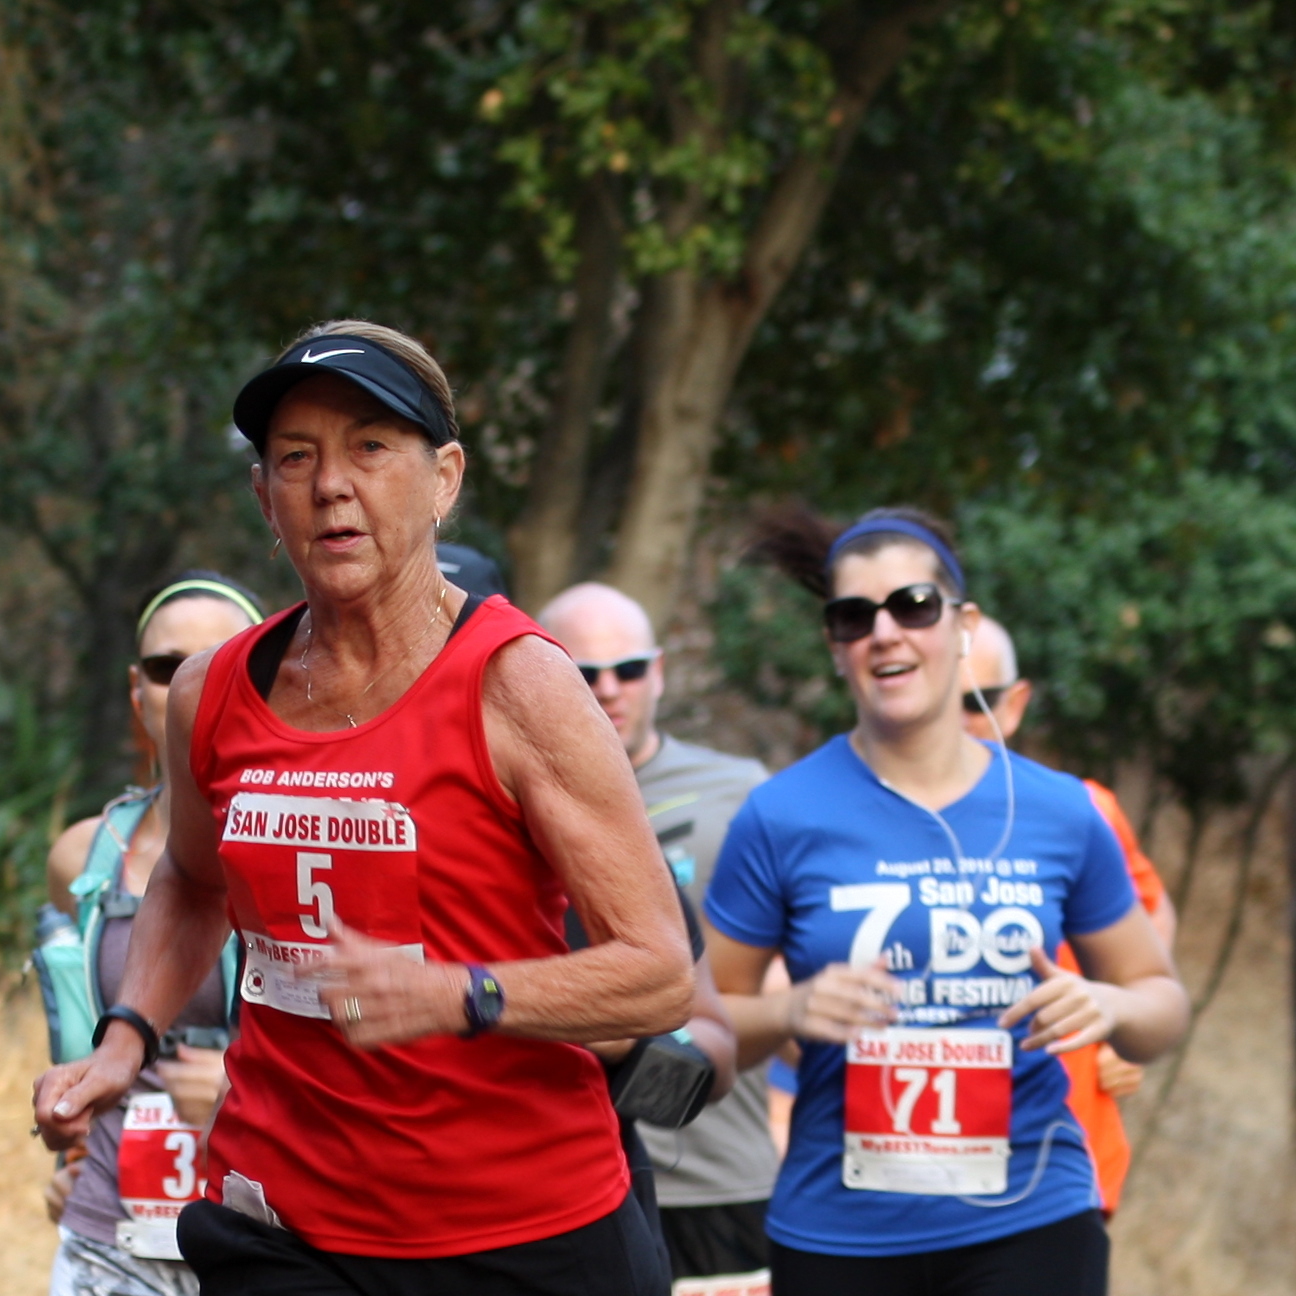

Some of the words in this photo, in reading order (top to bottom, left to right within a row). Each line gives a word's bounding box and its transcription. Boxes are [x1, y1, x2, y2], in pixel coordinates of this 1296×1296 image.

[240, 768, 275, 786] BOB
[277, 770, 395, 788] ANDERSON'S
[230, 810, 269, 837] SAN
[272, 812, 321, 842] JOSE
[327, 816, 407, 846] DOUBLE
[296, 851, 335, 939] 5
[919, 876, 975, 907] San
[980, 876, 1044, 907] Jose
[856, 1040, 888, 1059] SAN
[895, 1041, 935, 1061] JOSE
[942, 1042, 1003, 1063] DOUBLE
[134, 1107, 163, 1124] SAN
[893, 1067, 962, 1135] 71
[162, 1130, 208, 1199] 3
